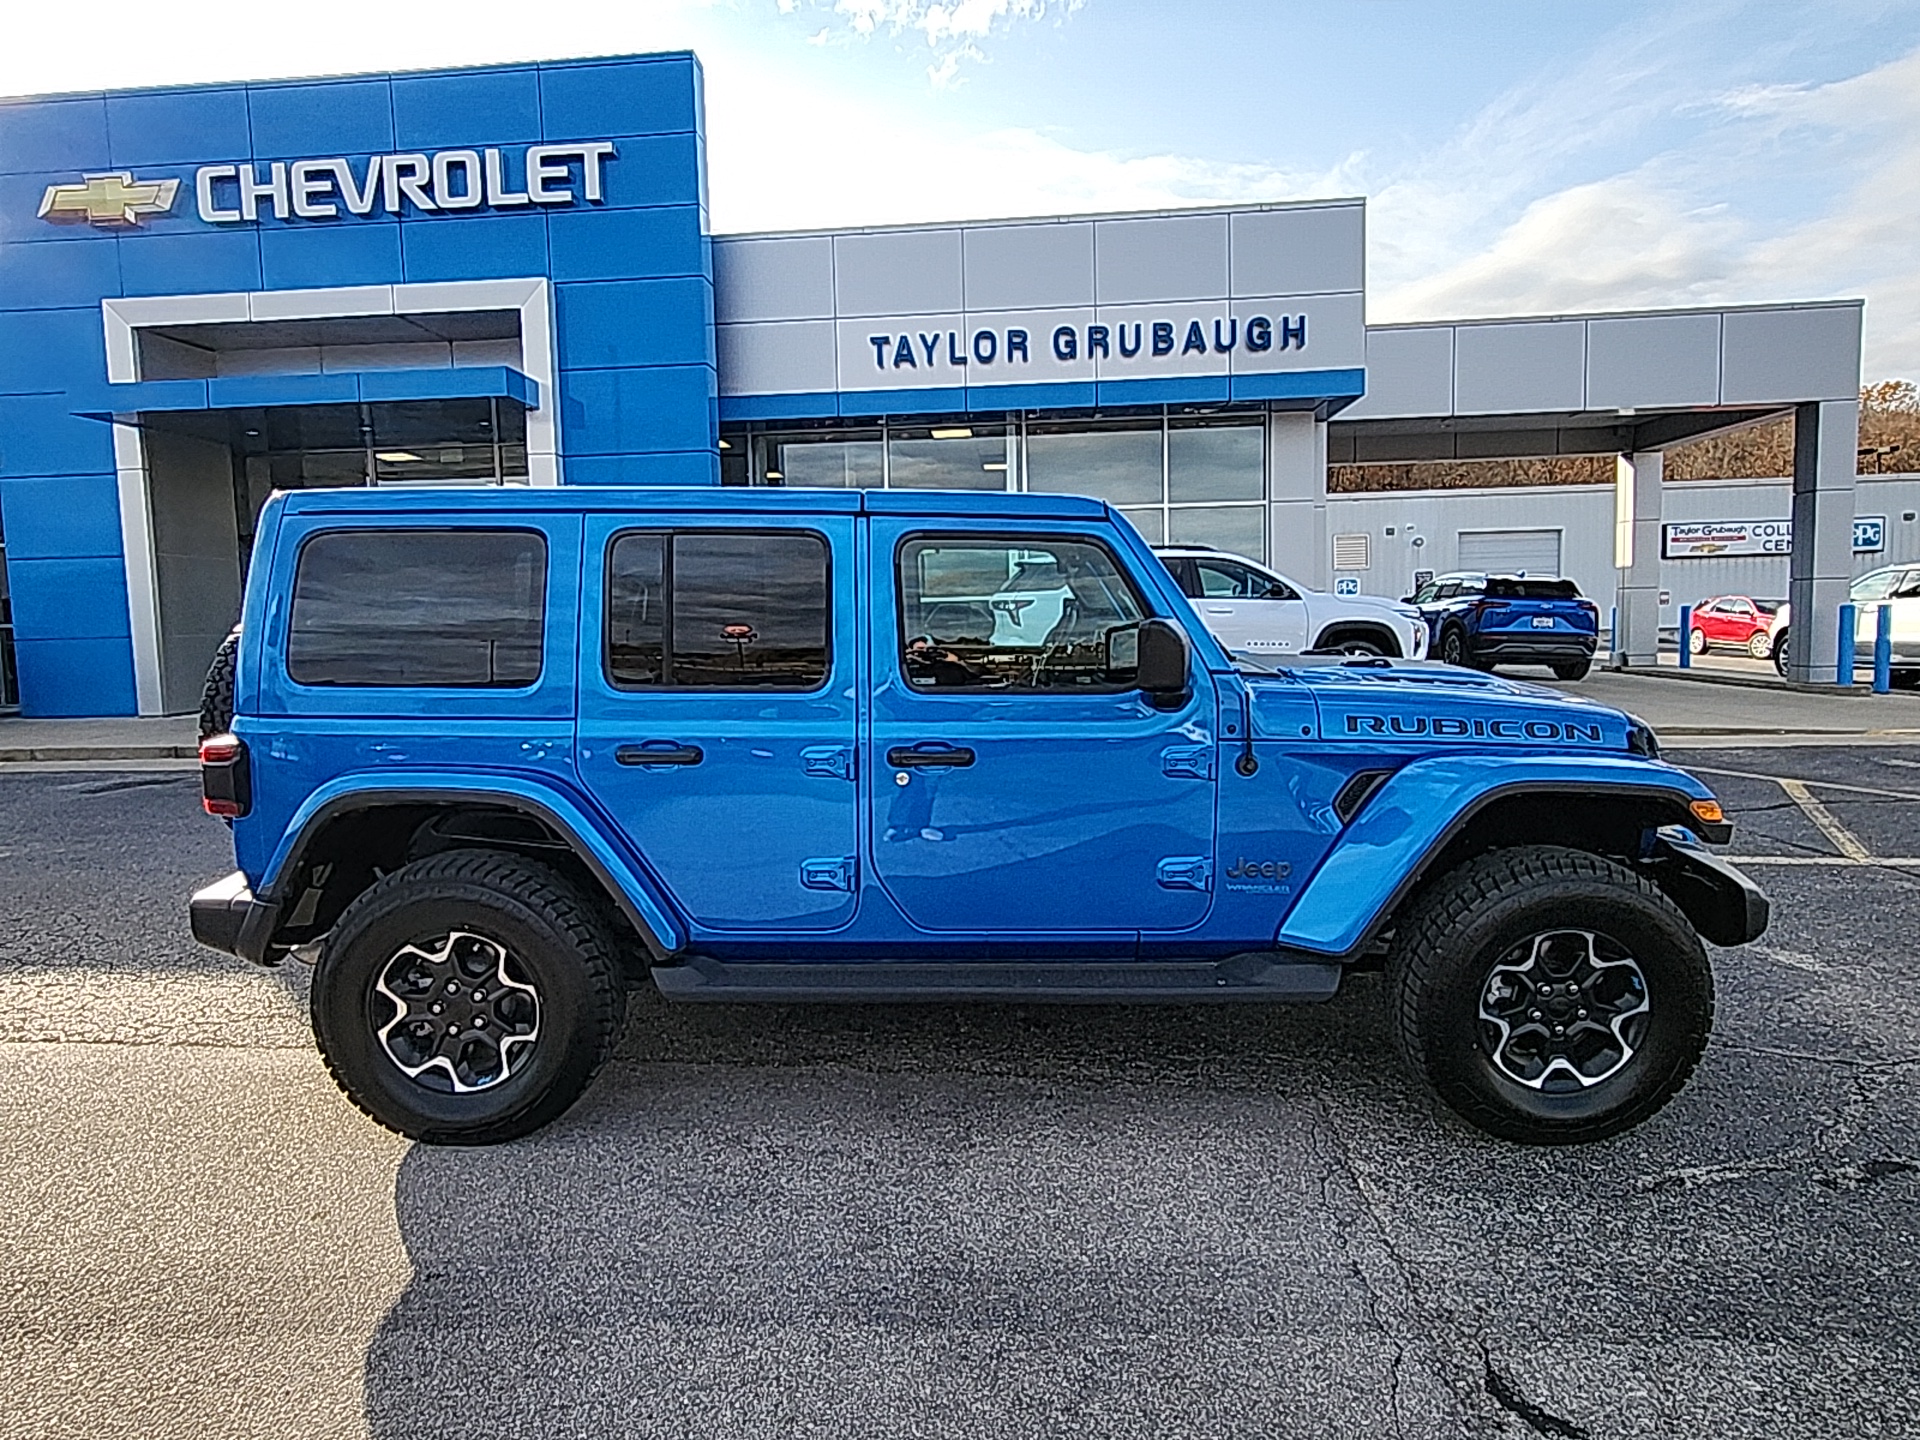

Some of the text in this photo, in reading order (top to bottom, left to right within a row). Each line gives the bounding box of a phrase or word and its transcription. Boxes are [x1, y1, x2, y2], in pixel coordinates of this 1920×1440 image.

[196, 140, 617, 225] CHEVROLET
[869, 314, 1308, 369] TAYLOR GRUBAUGH
[1671, 525, 1747, 537] Taylor Grubaugh
[1338, 581, 1357, 594] PPG
[1346, 714, 1602, 742] RUBICON
[1226, 856, 1292, 881] Jeep
